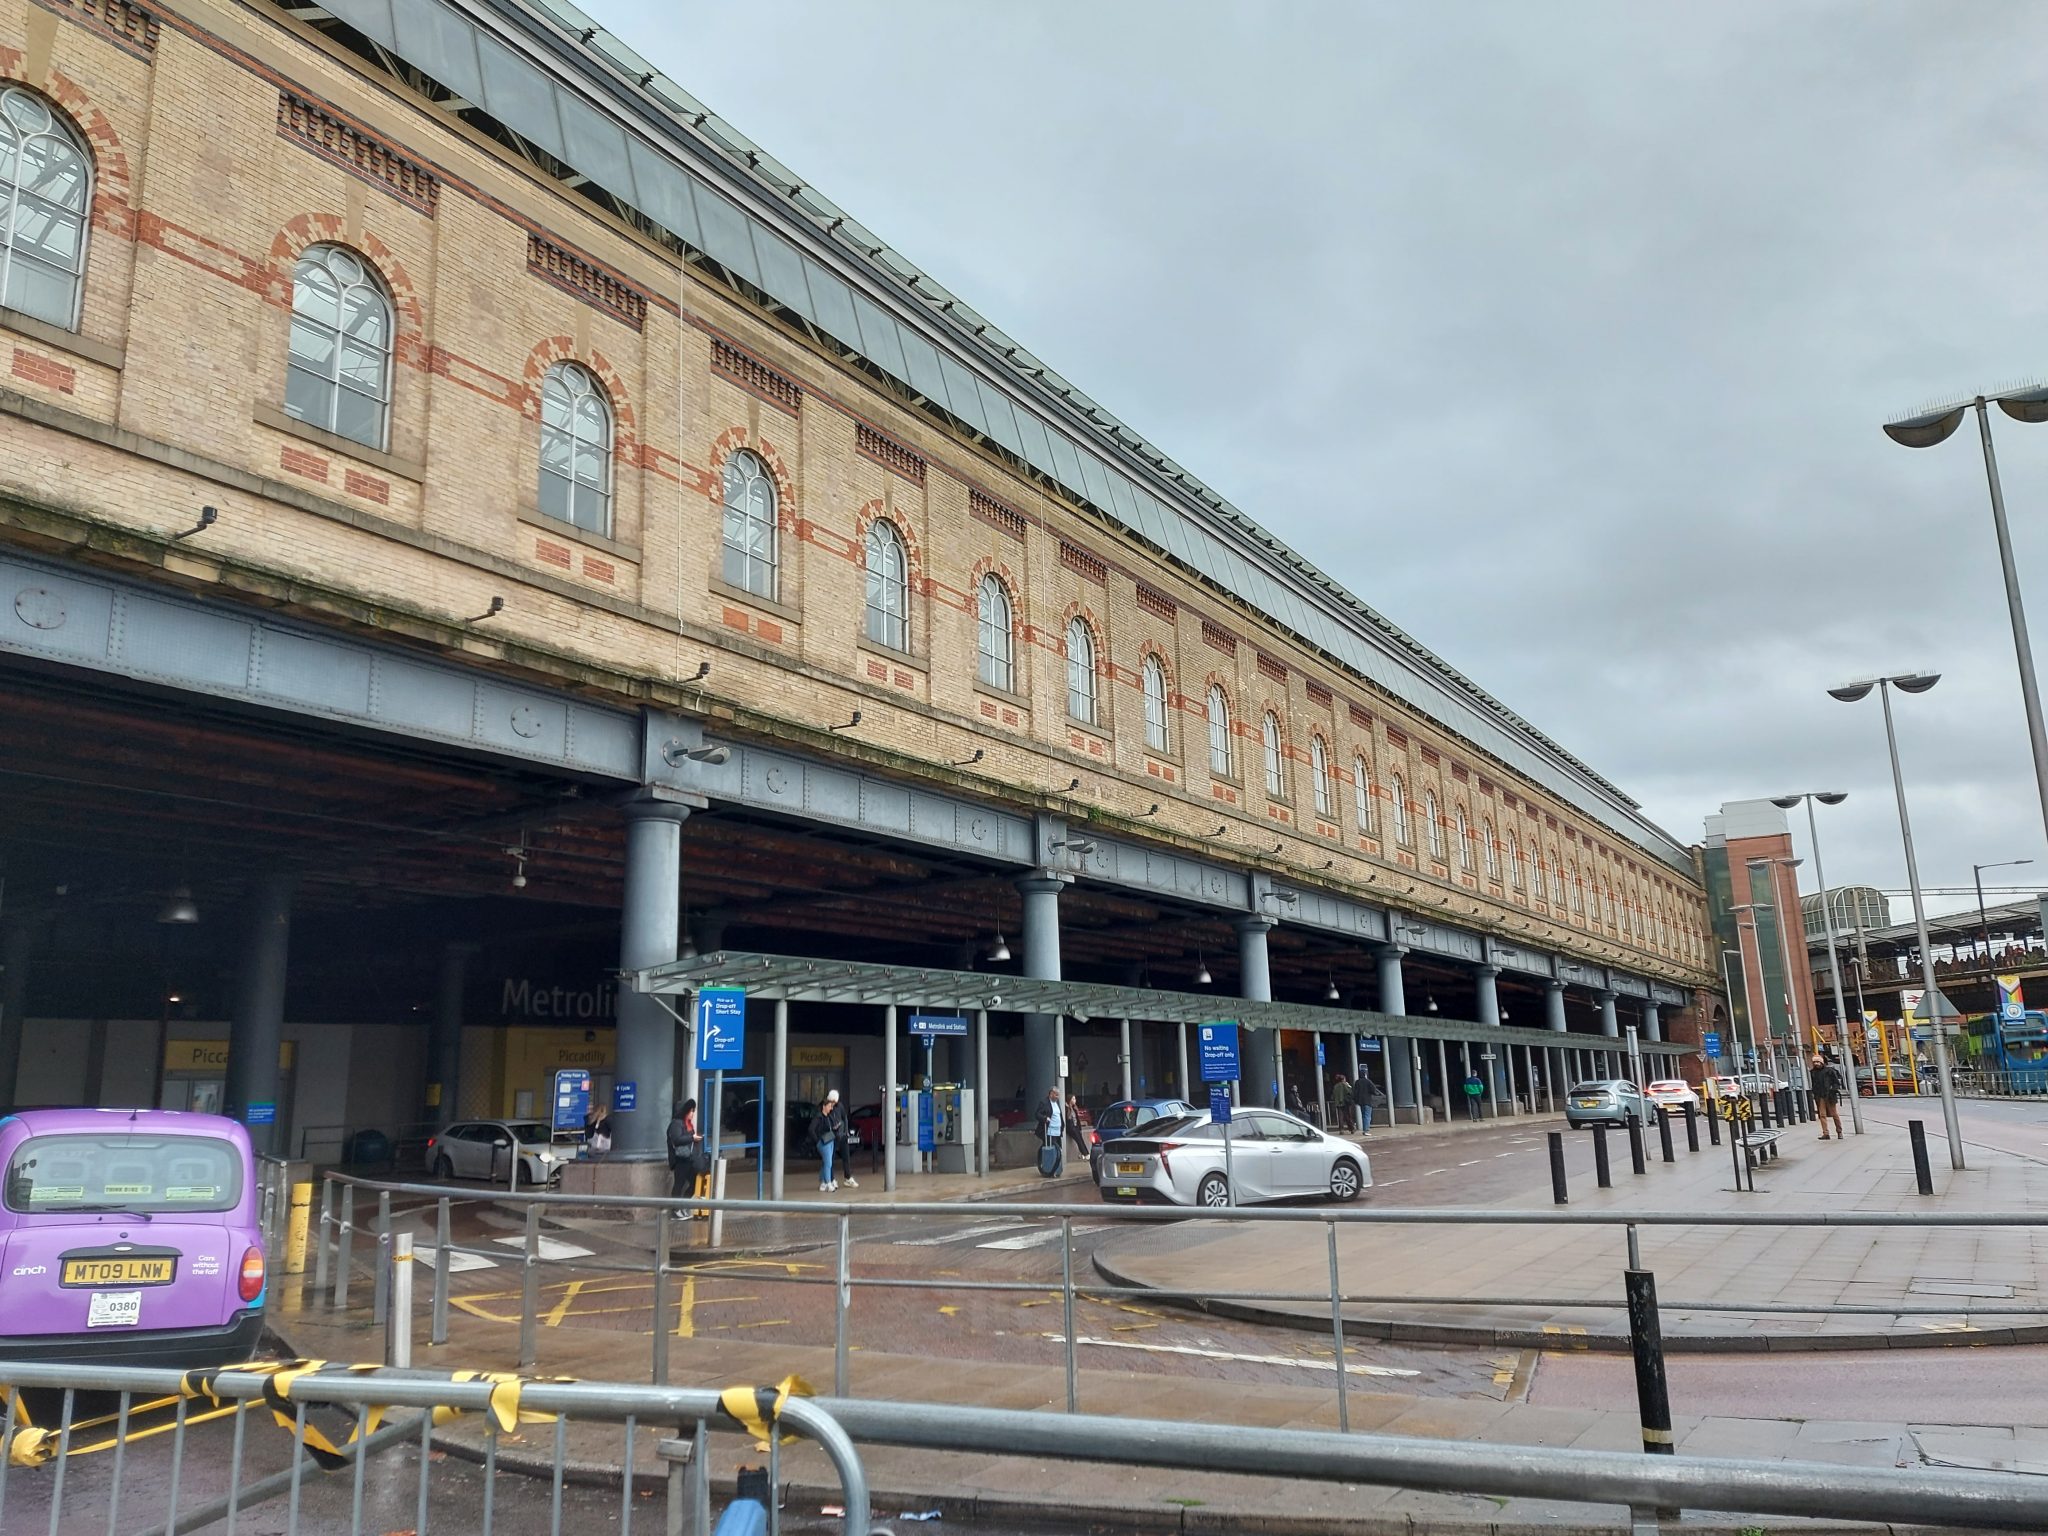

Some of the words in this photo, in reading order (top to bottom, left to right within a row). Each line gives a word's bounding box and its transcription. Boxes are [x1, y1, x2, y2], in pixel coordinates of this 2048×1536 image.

[502, 978, 617, 1018] Metroli
[558, 1049, 606, 1066] Piccadilly
[800, 1051, 832, 1065] Piccadilly
[13, 1264, 47, 1276] cinch
[74, 1264, 123, 1280] MT09
[128, 1263, 164, 1279] LNW
[109, 1301, 137, 1312] 0380
